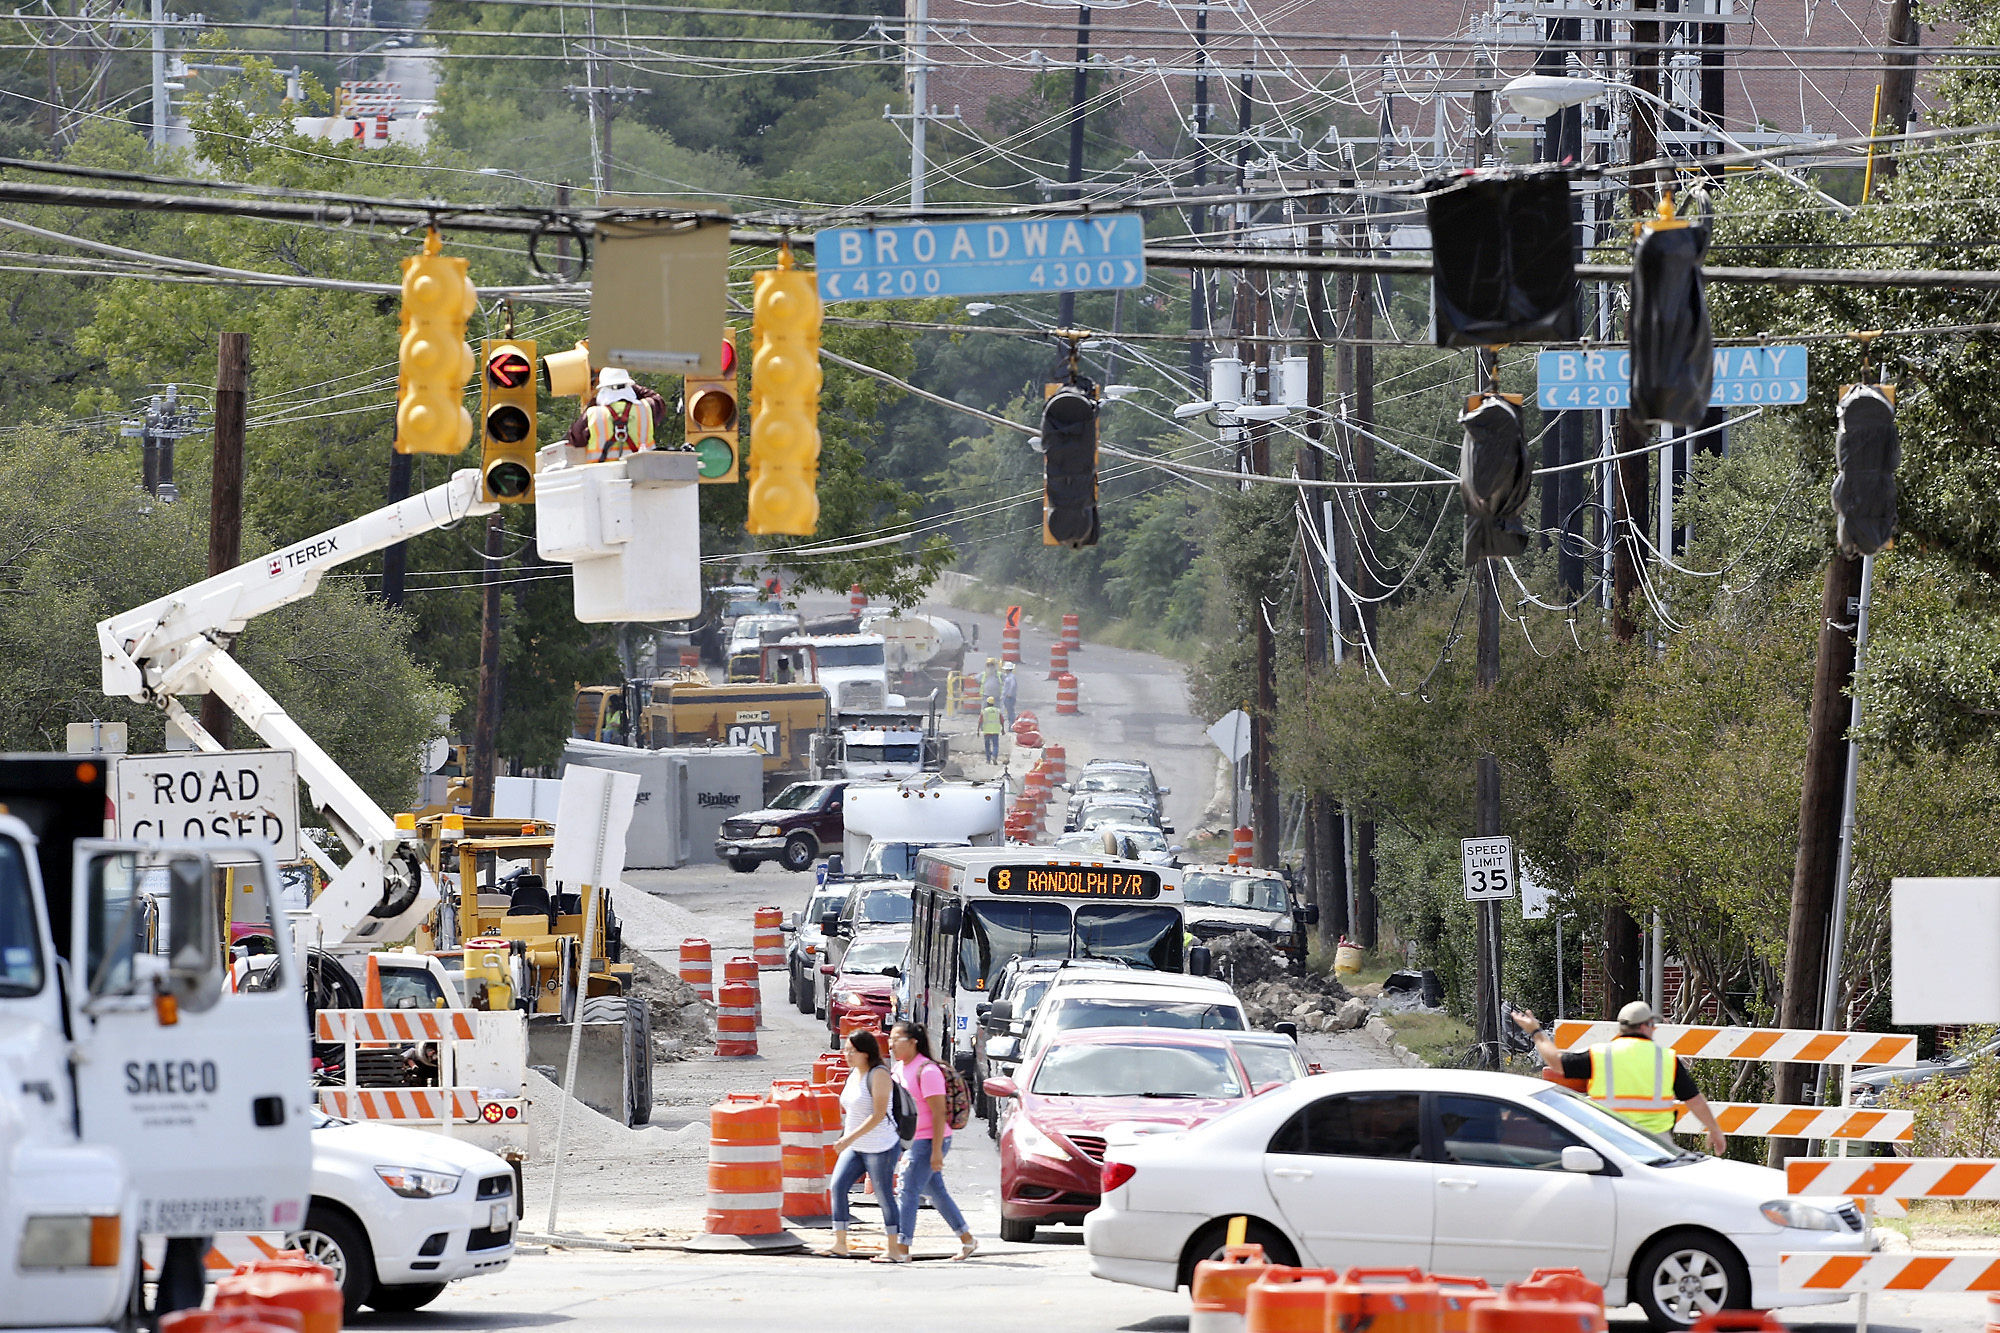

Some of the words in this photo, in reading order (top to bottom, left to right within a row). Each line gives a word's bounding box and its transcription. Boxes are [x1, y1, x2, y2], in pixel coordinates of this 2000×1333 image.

[840, 220, 1118, 266] BROADWAY
[853, 269, 941, 296] 4200
[1029, 261, 1114, 287] 4300
[1558, 349, 1787, 382] BROWAY
[1711, 382, 1783, 402] 4300
[285, 536, 339, 568] TEREX
[728, 725, 777, 755] CAT
[154, 769, 260, 805] ROAD
[697, 792, 741, 805] Rinker
[1467, 844, 1507, 856] SPEED
[1471, 857, 1503, 868] LIMIT
[997, 869, 1012, 891] 8
[1027, 870, 1108, 894] RANDOLPH
[1111, 873, 1144, 896] P/R
[1470, 869, 1508, 893] 35
[975, 978, 985, 990] 3
[125, 1060, 218, 1095] SAECO
